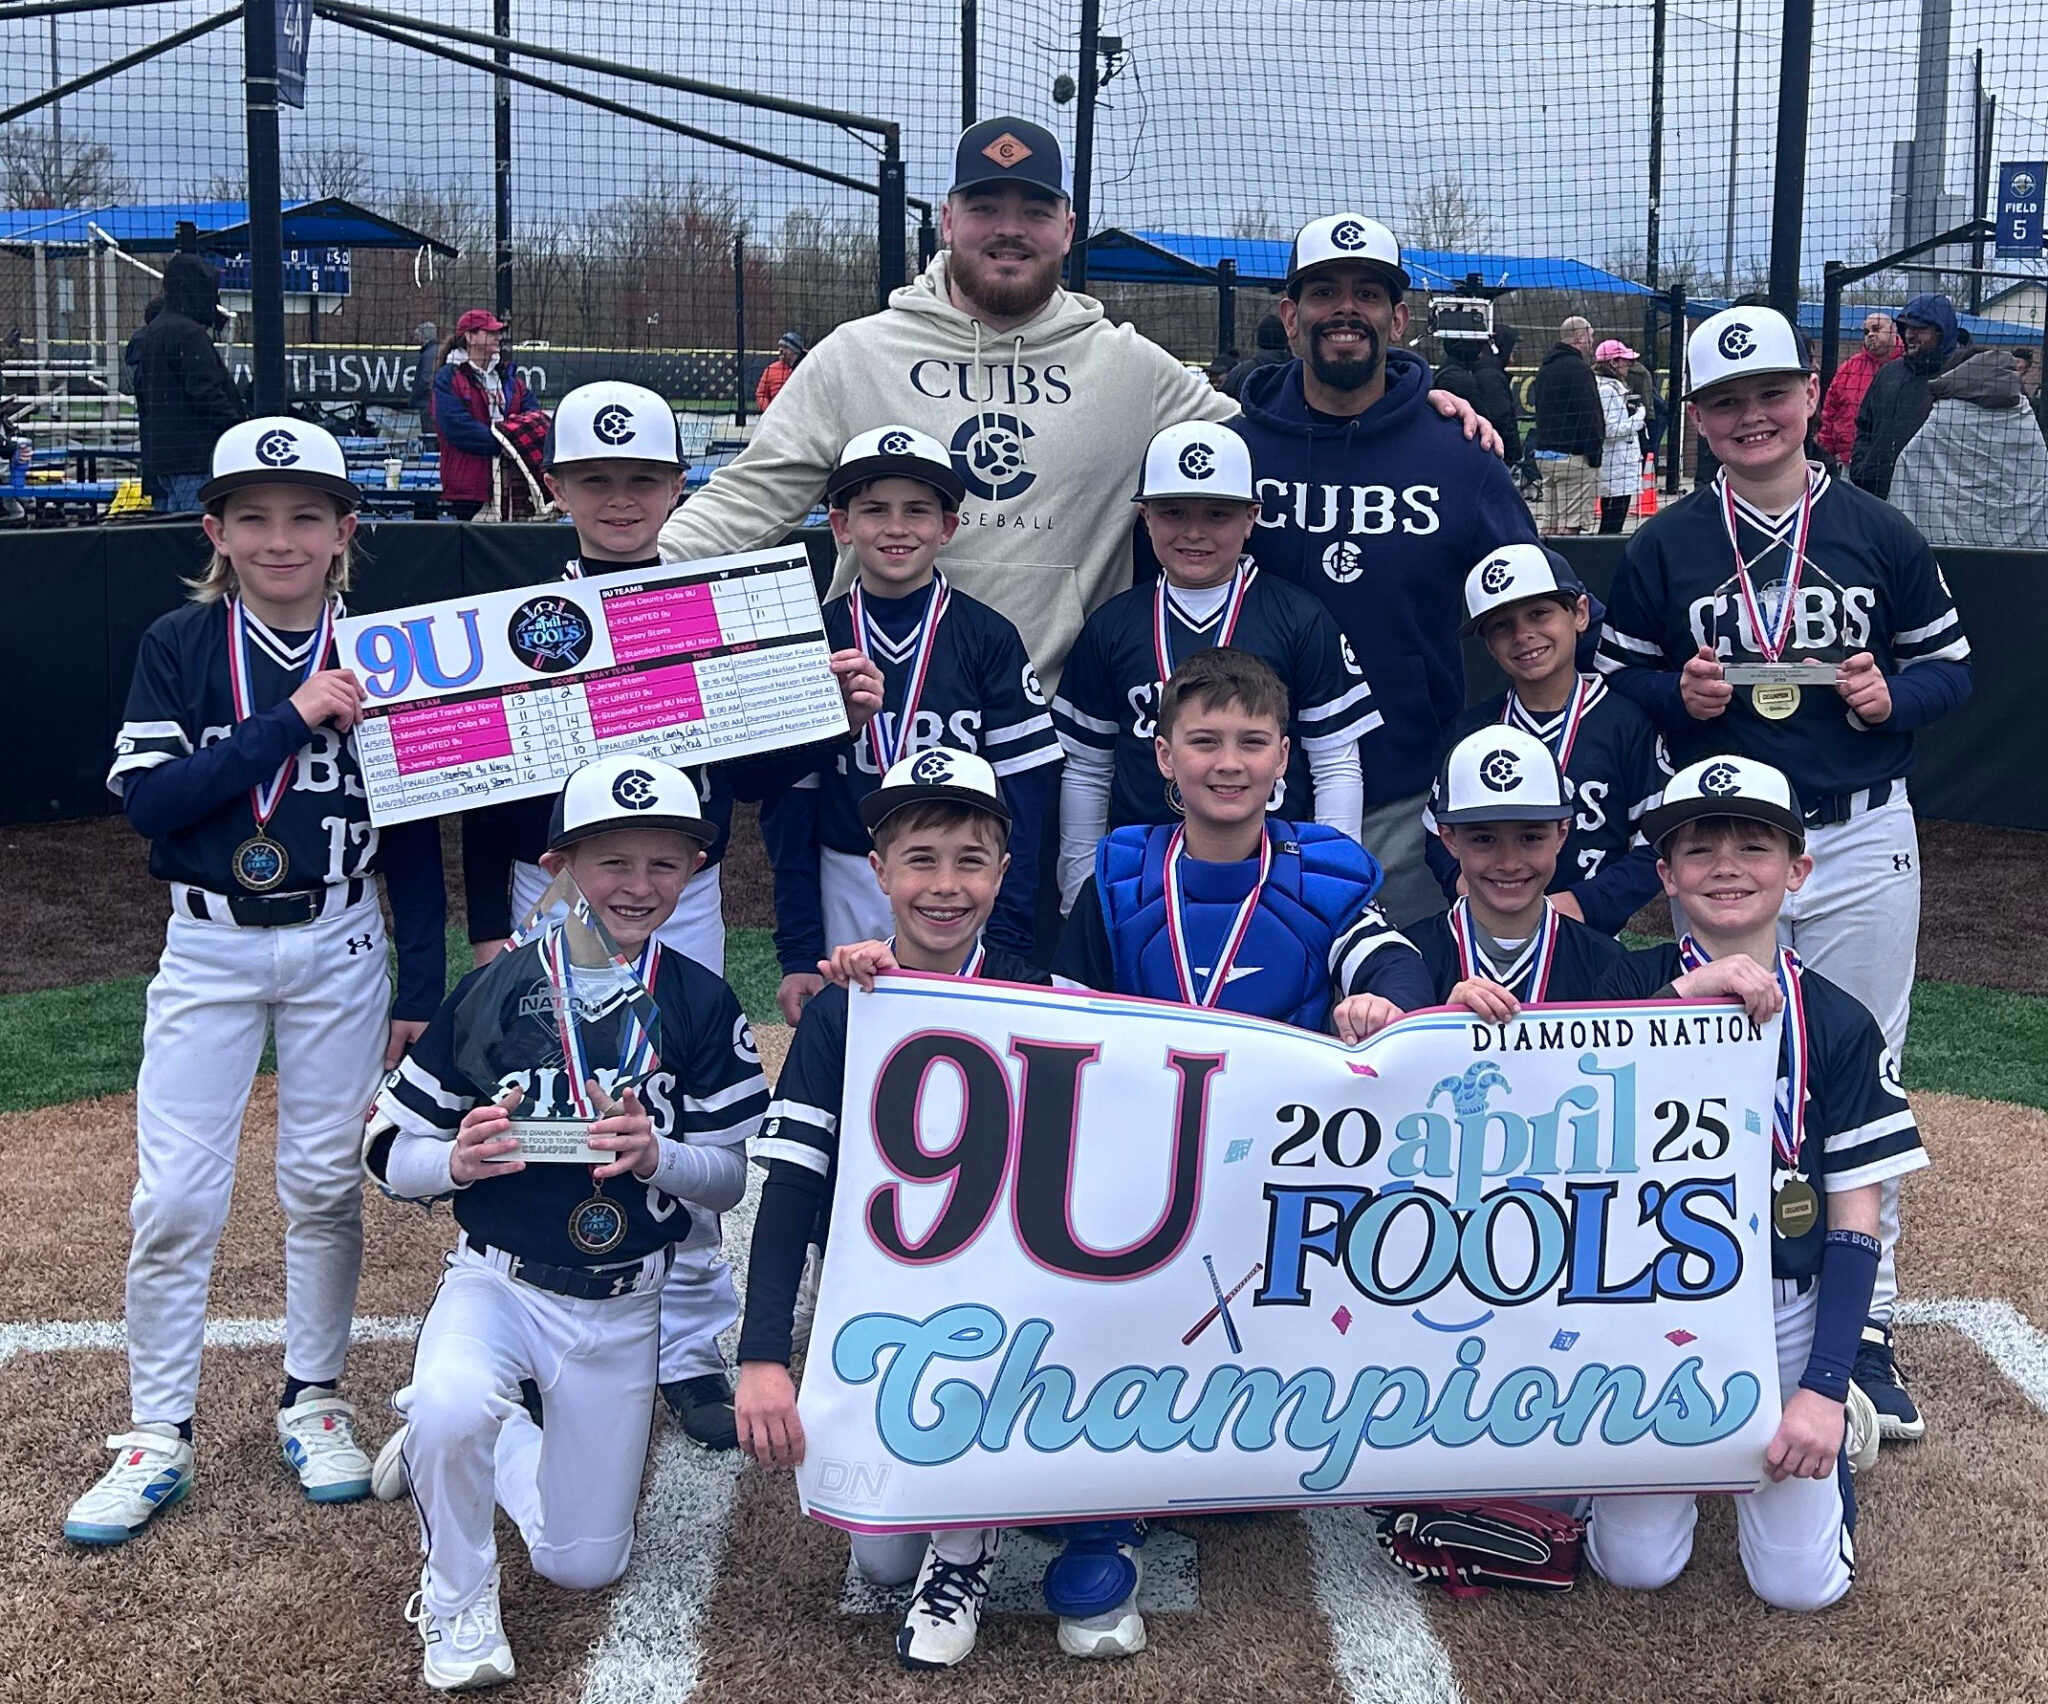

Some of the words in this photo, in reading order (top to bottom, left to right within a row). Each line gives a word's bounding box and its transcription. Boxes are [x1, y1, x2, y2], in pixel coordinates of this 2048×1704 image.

[2005, 203, 2037, 213] FIELD
[2013, 220, 2027, 240] 5
[910, 359, 1071, 405] CUBS
[1255, 478, 1440, 535] CUBS
[960, 511, 1055, 530] SEBALL
[614, 585, 644, 595] TEAMS
[1689, 586, 1876, 657] CUBS
[355, 608, 484, 699] 9U
[501, 683, 531, 694] SCORE
[416, 698, 441, 708] TEAM
[510, 694, 526, 706] 13
[362, 709, 380, 717] ATE
[519, 710, 527, 721] 11
[519, 725, 530, 736] 2
[523, 740, 532, 750] 5
[524, 754, 532, 765] 4
[523, 769, 536, 780] 16
[321, 815, 380, 884] 12
[1472, 1018, 1634, 1052] DIAMOND
[1649, 1015, 1763, 1048] NATION
[1271, 1103, 1382, 1168] 20
[1387, 1052, 1640, 1211] april
[1652, 1097, 1731, 1163] 25
[863, 1026, 1229, 1283] 9U
[1253, 1173, 1744, 1307] FOOL'S
[1852, 1232, 1881, 1252] BOLT
[832, 1302, 1761, 1492] Champions
[815, 1456, 893, 1502] DN
